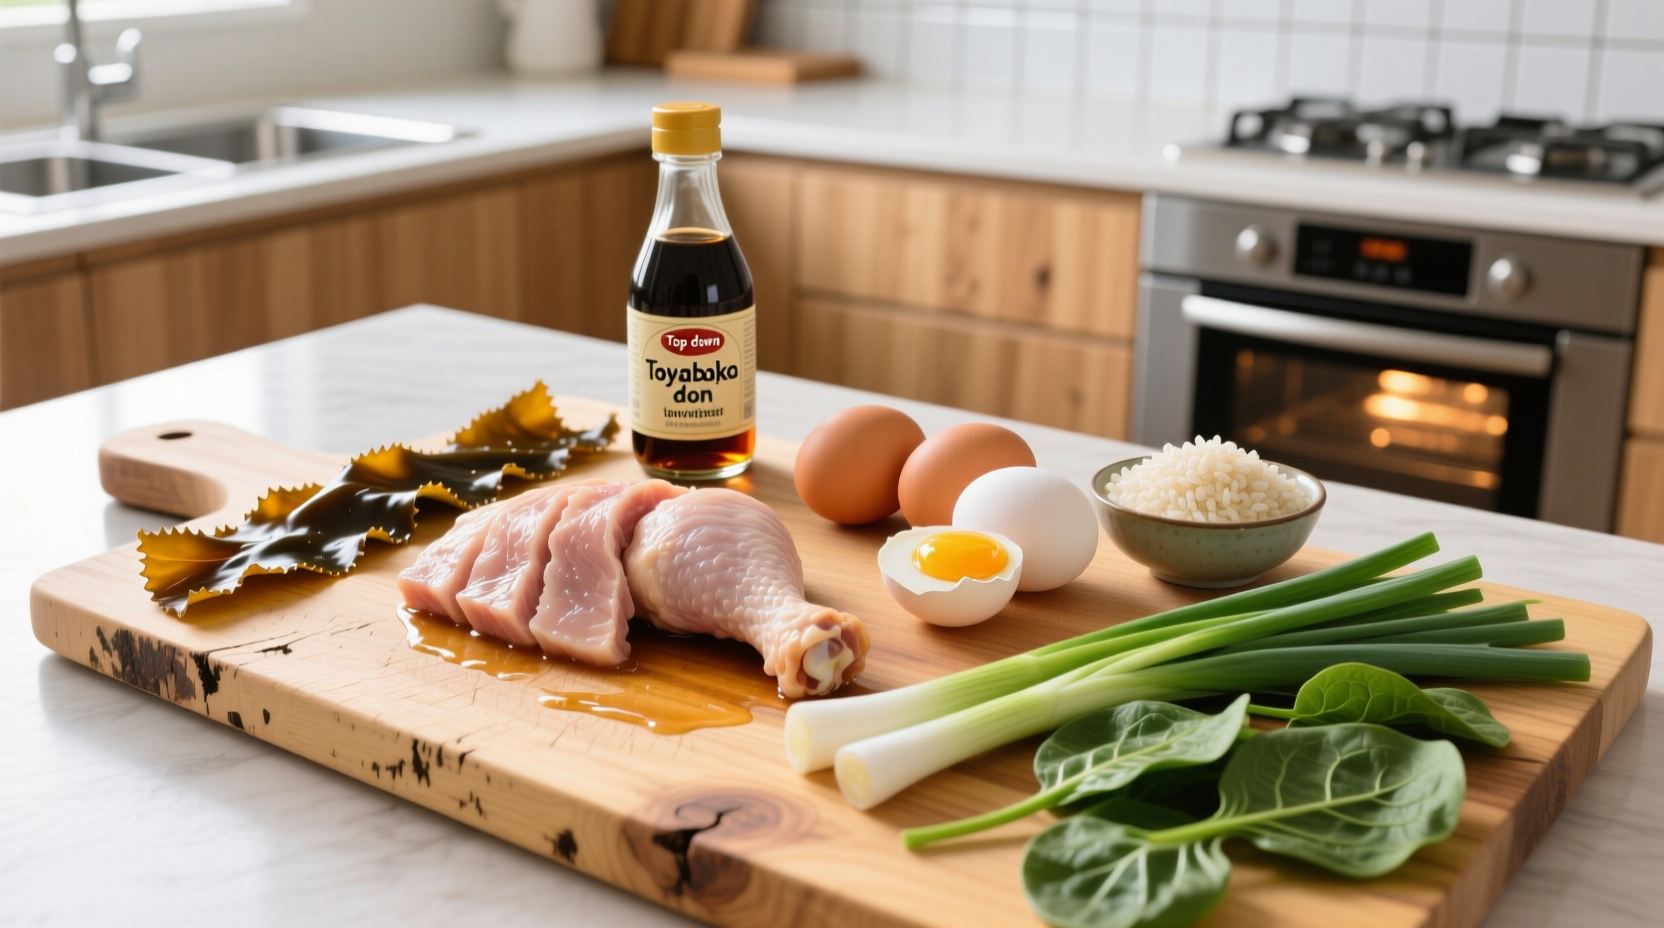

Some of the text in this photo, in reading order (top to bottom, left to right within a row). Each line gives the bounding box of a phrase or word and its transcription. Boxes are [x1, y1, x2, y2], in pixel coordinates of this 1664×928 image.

[665, 334, 720, 351] Top down
[673, 384, 713, 403] don
